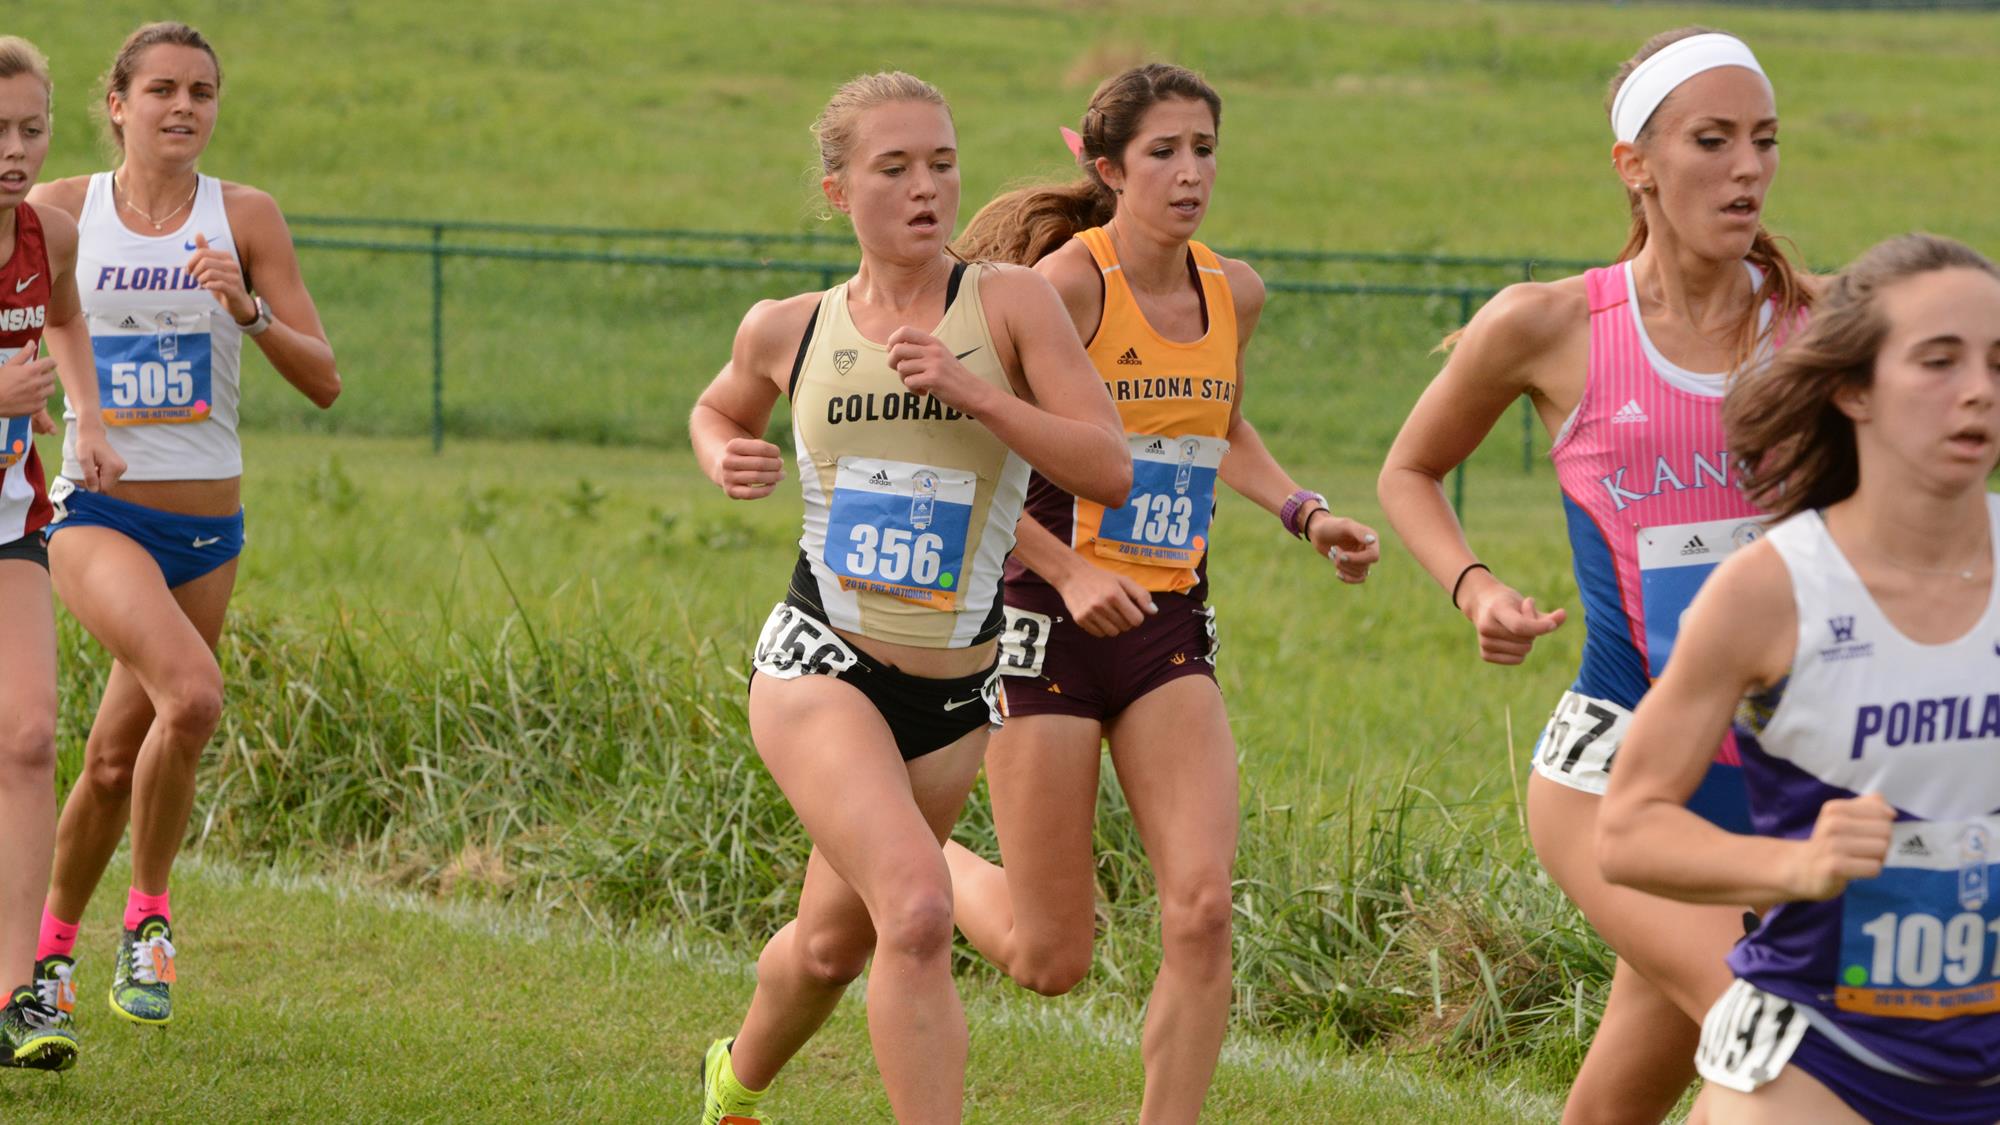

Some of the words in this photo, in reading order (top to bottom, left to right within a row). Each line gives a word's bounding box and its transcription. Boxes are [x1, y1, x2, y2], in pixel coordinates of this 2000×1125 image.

[95, 266, 207, 291] FLORID
[111, 361, 193, 407] 505
[838, 360, 850, 370] 12
[828, 391, 975, 425] COLORAD
[1201, 379, 1235, 402] STA
[1131, 493, 1193, 546] 133
[846, 523, 944, 585] 356
[1543, 693, 1618, 775] 67
[1850, 693, 2000, 761] PORTLA
